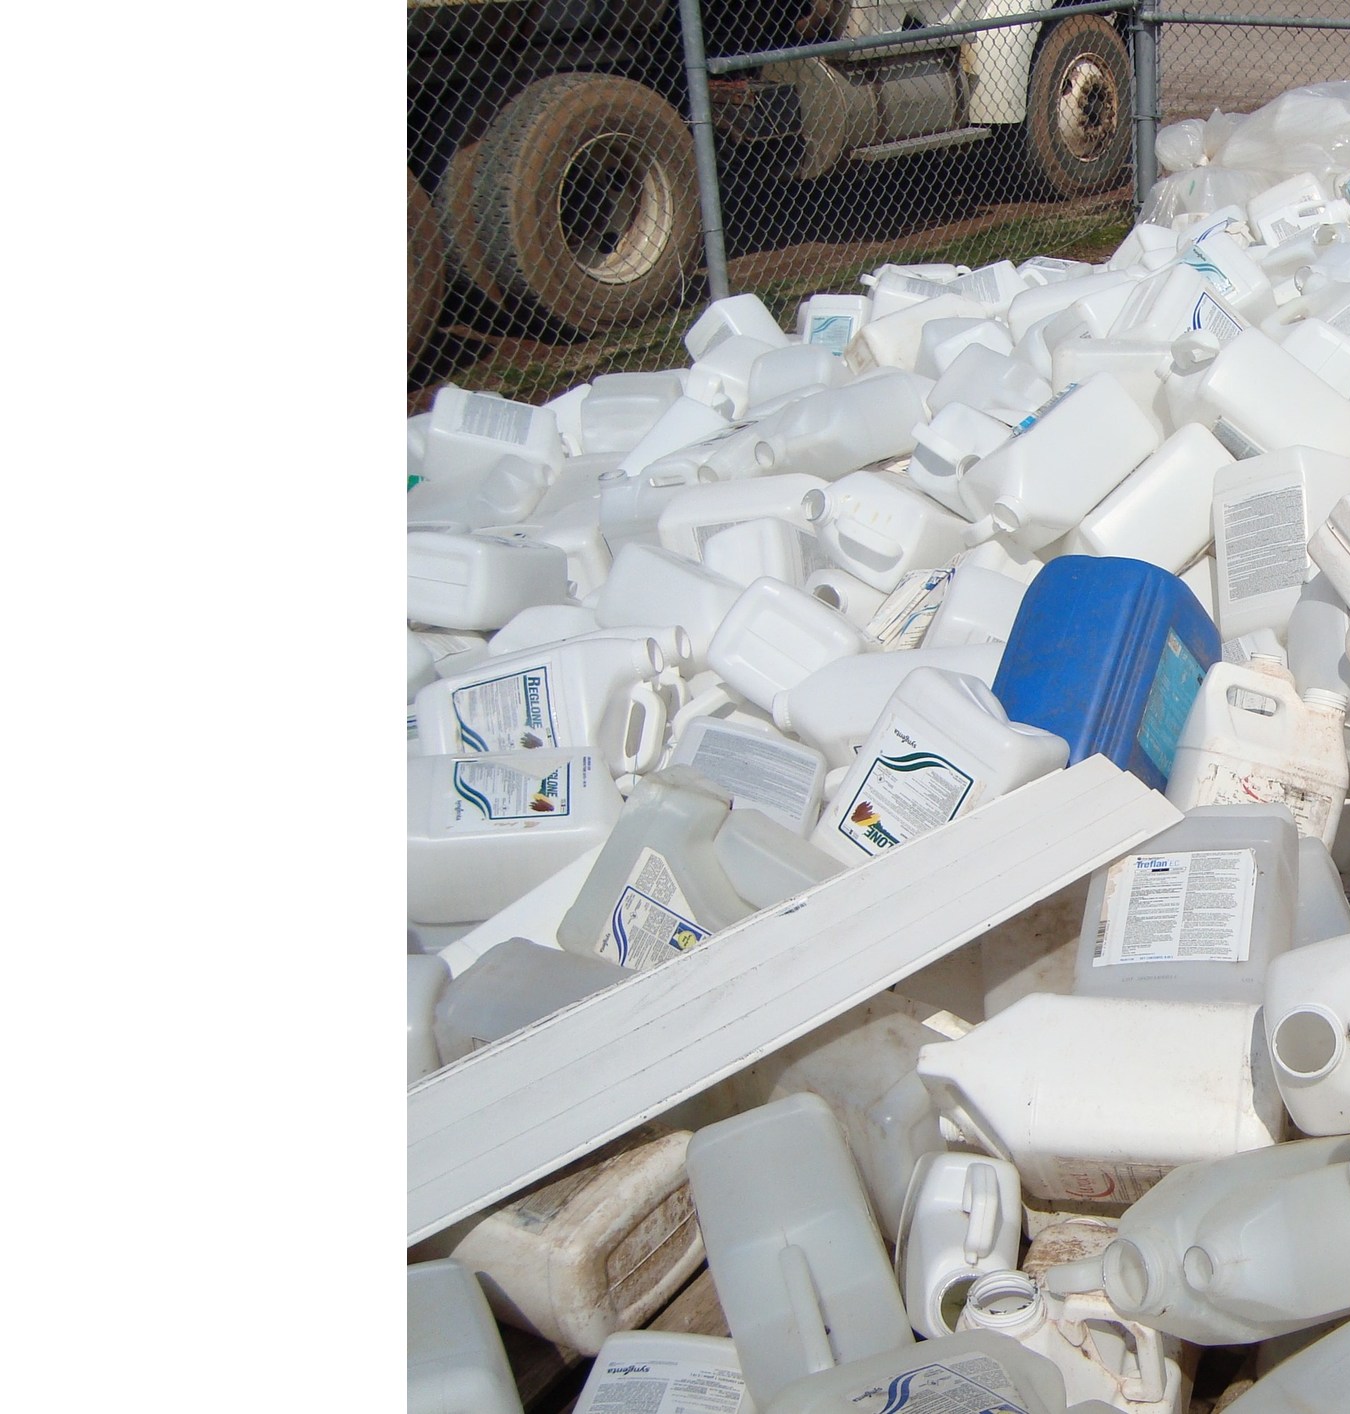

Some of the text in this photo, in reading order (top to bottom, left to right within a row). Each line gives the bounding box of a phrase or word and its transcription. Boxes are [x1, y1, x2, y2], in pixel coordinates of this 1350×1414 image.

[893, 728, 917, 749] syngenta
[1136, 859, 1168, 869] Treflan
[607, 1364, 651, 1376] syngenta
